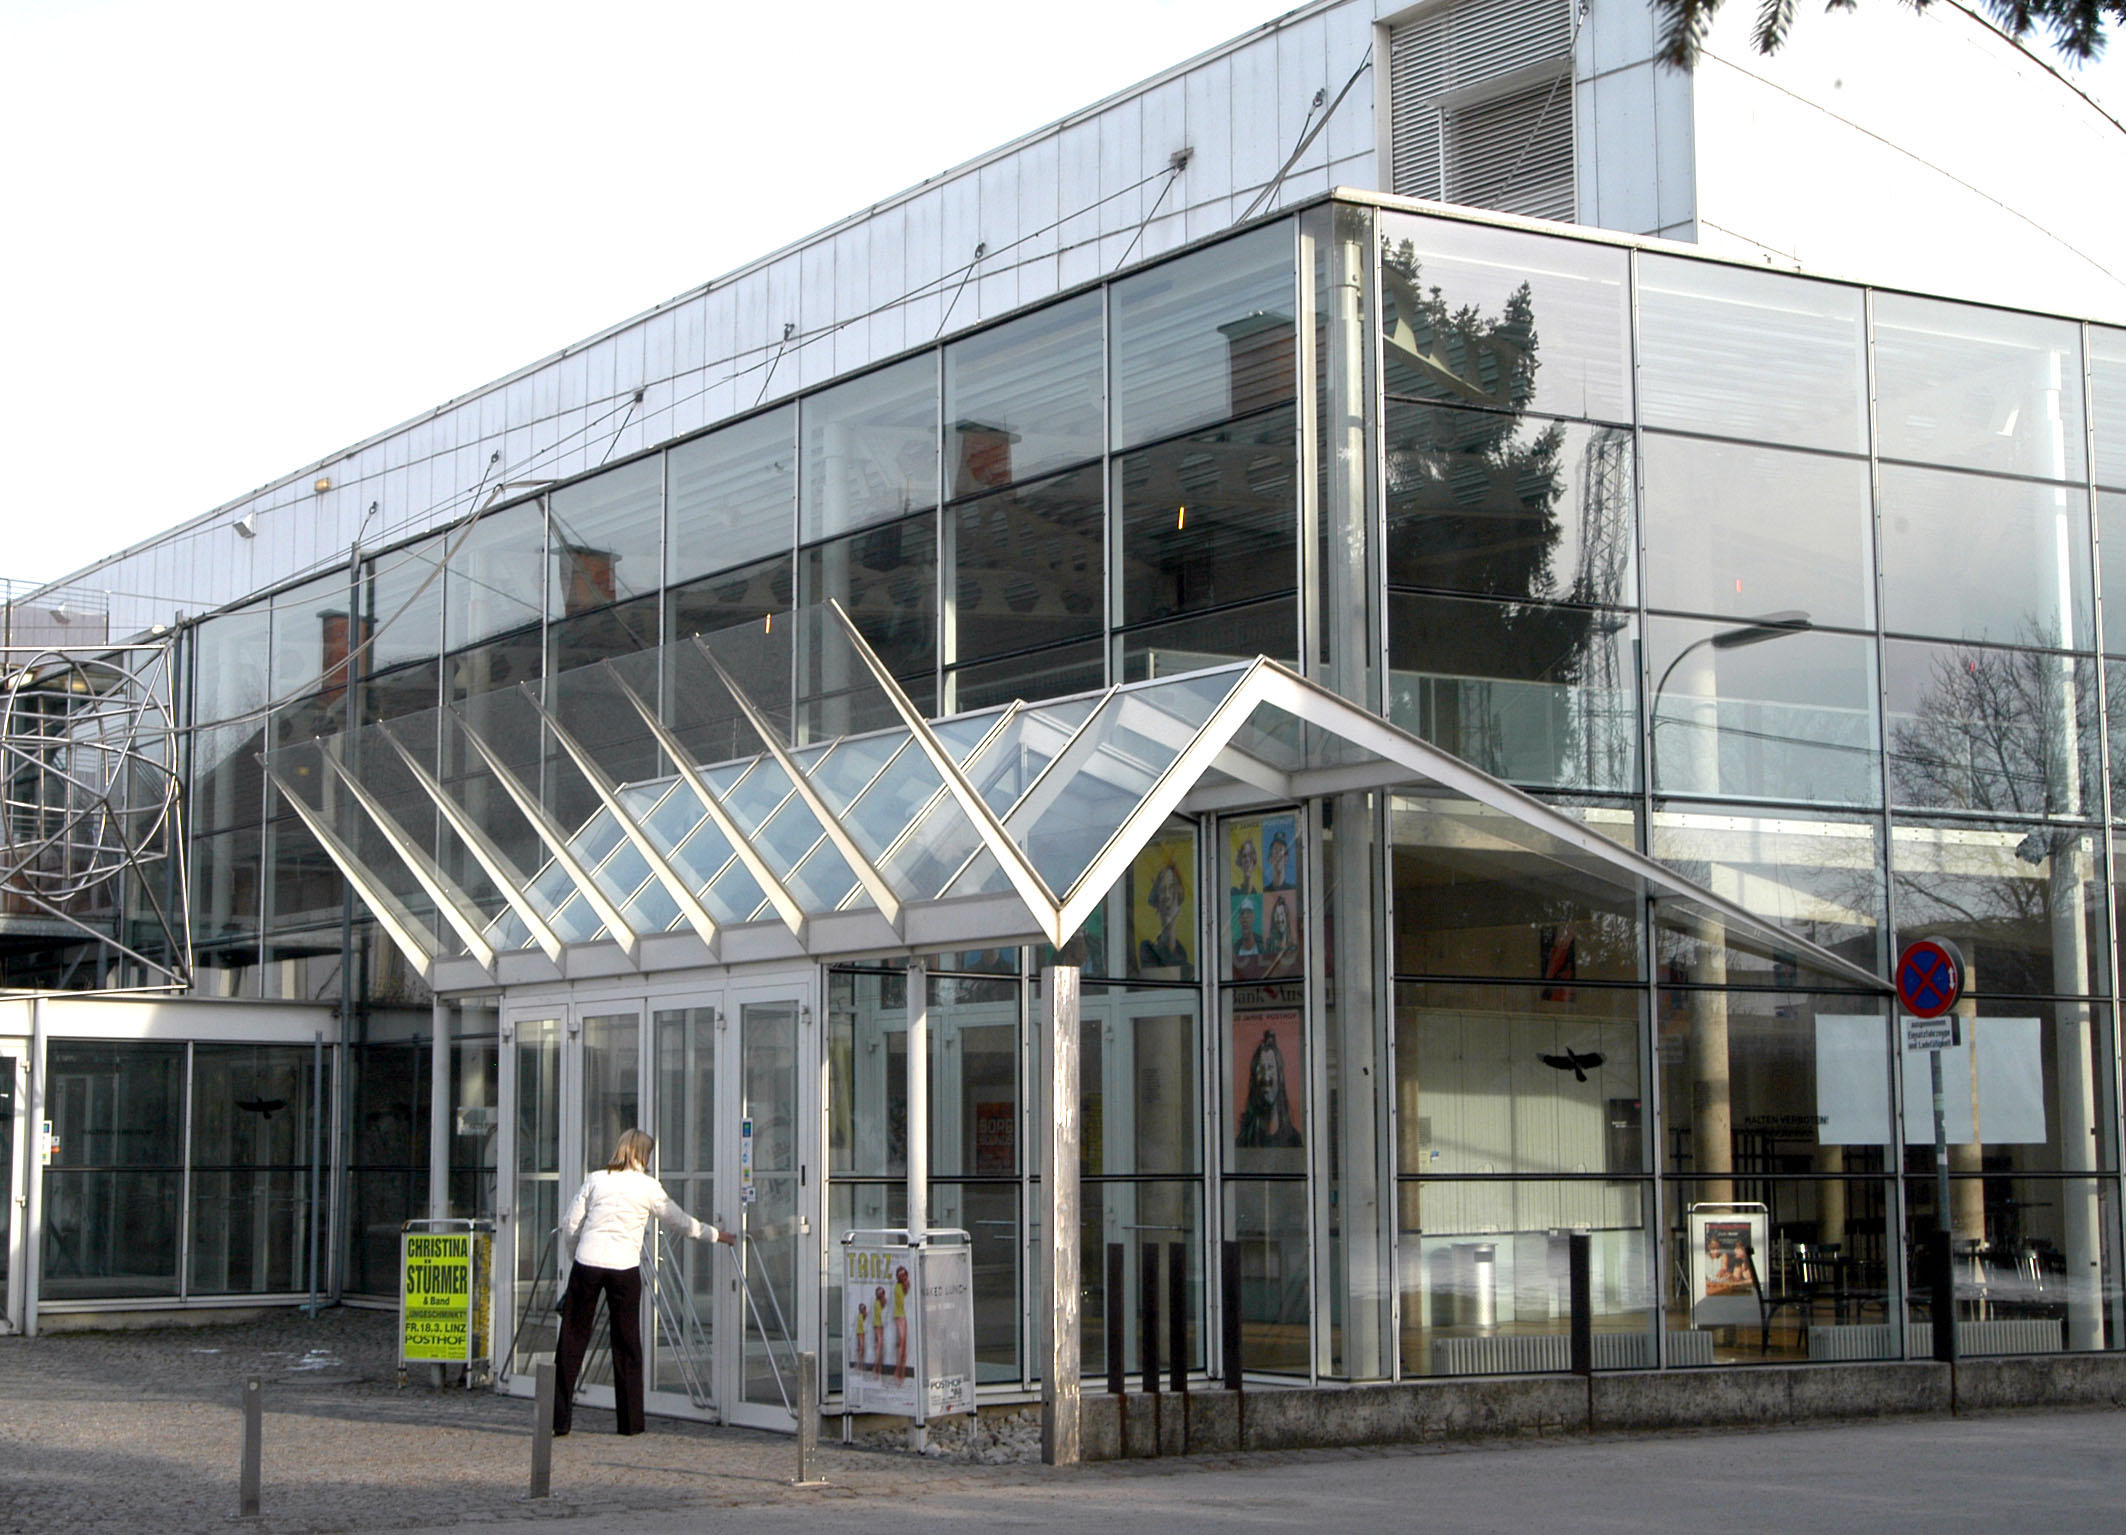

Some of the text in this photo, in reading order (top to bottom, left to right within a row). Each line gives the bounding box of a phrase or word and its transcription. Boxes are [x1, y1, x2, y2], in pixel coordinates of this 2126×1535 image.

[407, 1238, 468, 1258] CHRISTINA
[847, 1252, 893, 1279] TANZ
[406, 1260, 468, 1294] STÜRMER
[423, 1296, 450, 1305] & Band
[445, 1323, 466, 1333] LINZ
[404, 1335, 466, 1345] POSTHOF
